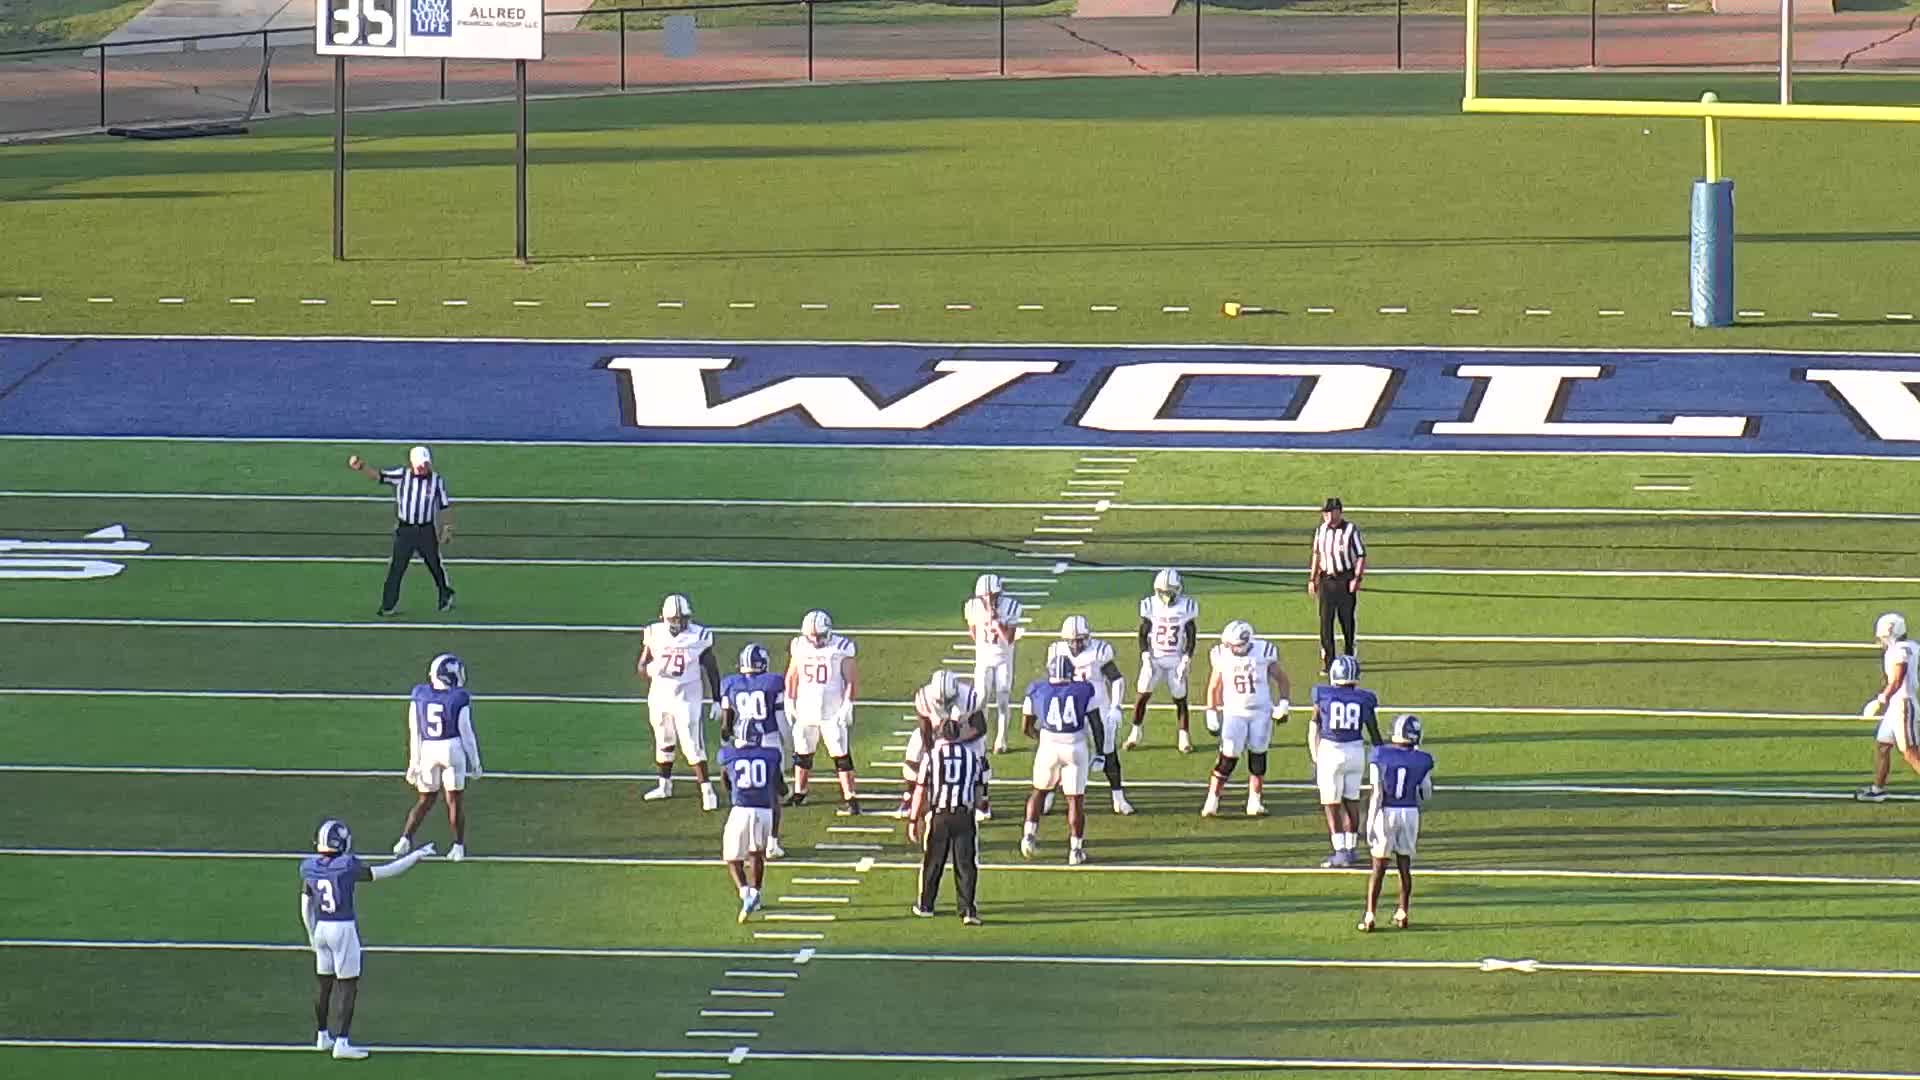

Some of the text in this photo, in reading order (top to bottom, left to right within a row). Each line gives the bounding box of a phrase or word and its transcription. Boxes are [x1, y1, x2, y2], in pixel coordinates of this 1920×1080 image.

[412, 8, 450, 23] YORK
[470, 7, 526, 19] ALLRED
[417, 19, 447, 33] LIFE
[1156, 625, 1180, 647] 23
[660, 654, 685, 677] 79
[803, 663, 828, 684] 50
[1234, 674, 1256, 695] 61
[426, 702, 445, 738] 5
[1046, 696, 1077, 731] 44
[1329, 701, 1361, 731] 88
[944, 759, 962, 783] U
[1395, 767, 1407, 800] 1
[317, 878, 337, 914] 3
